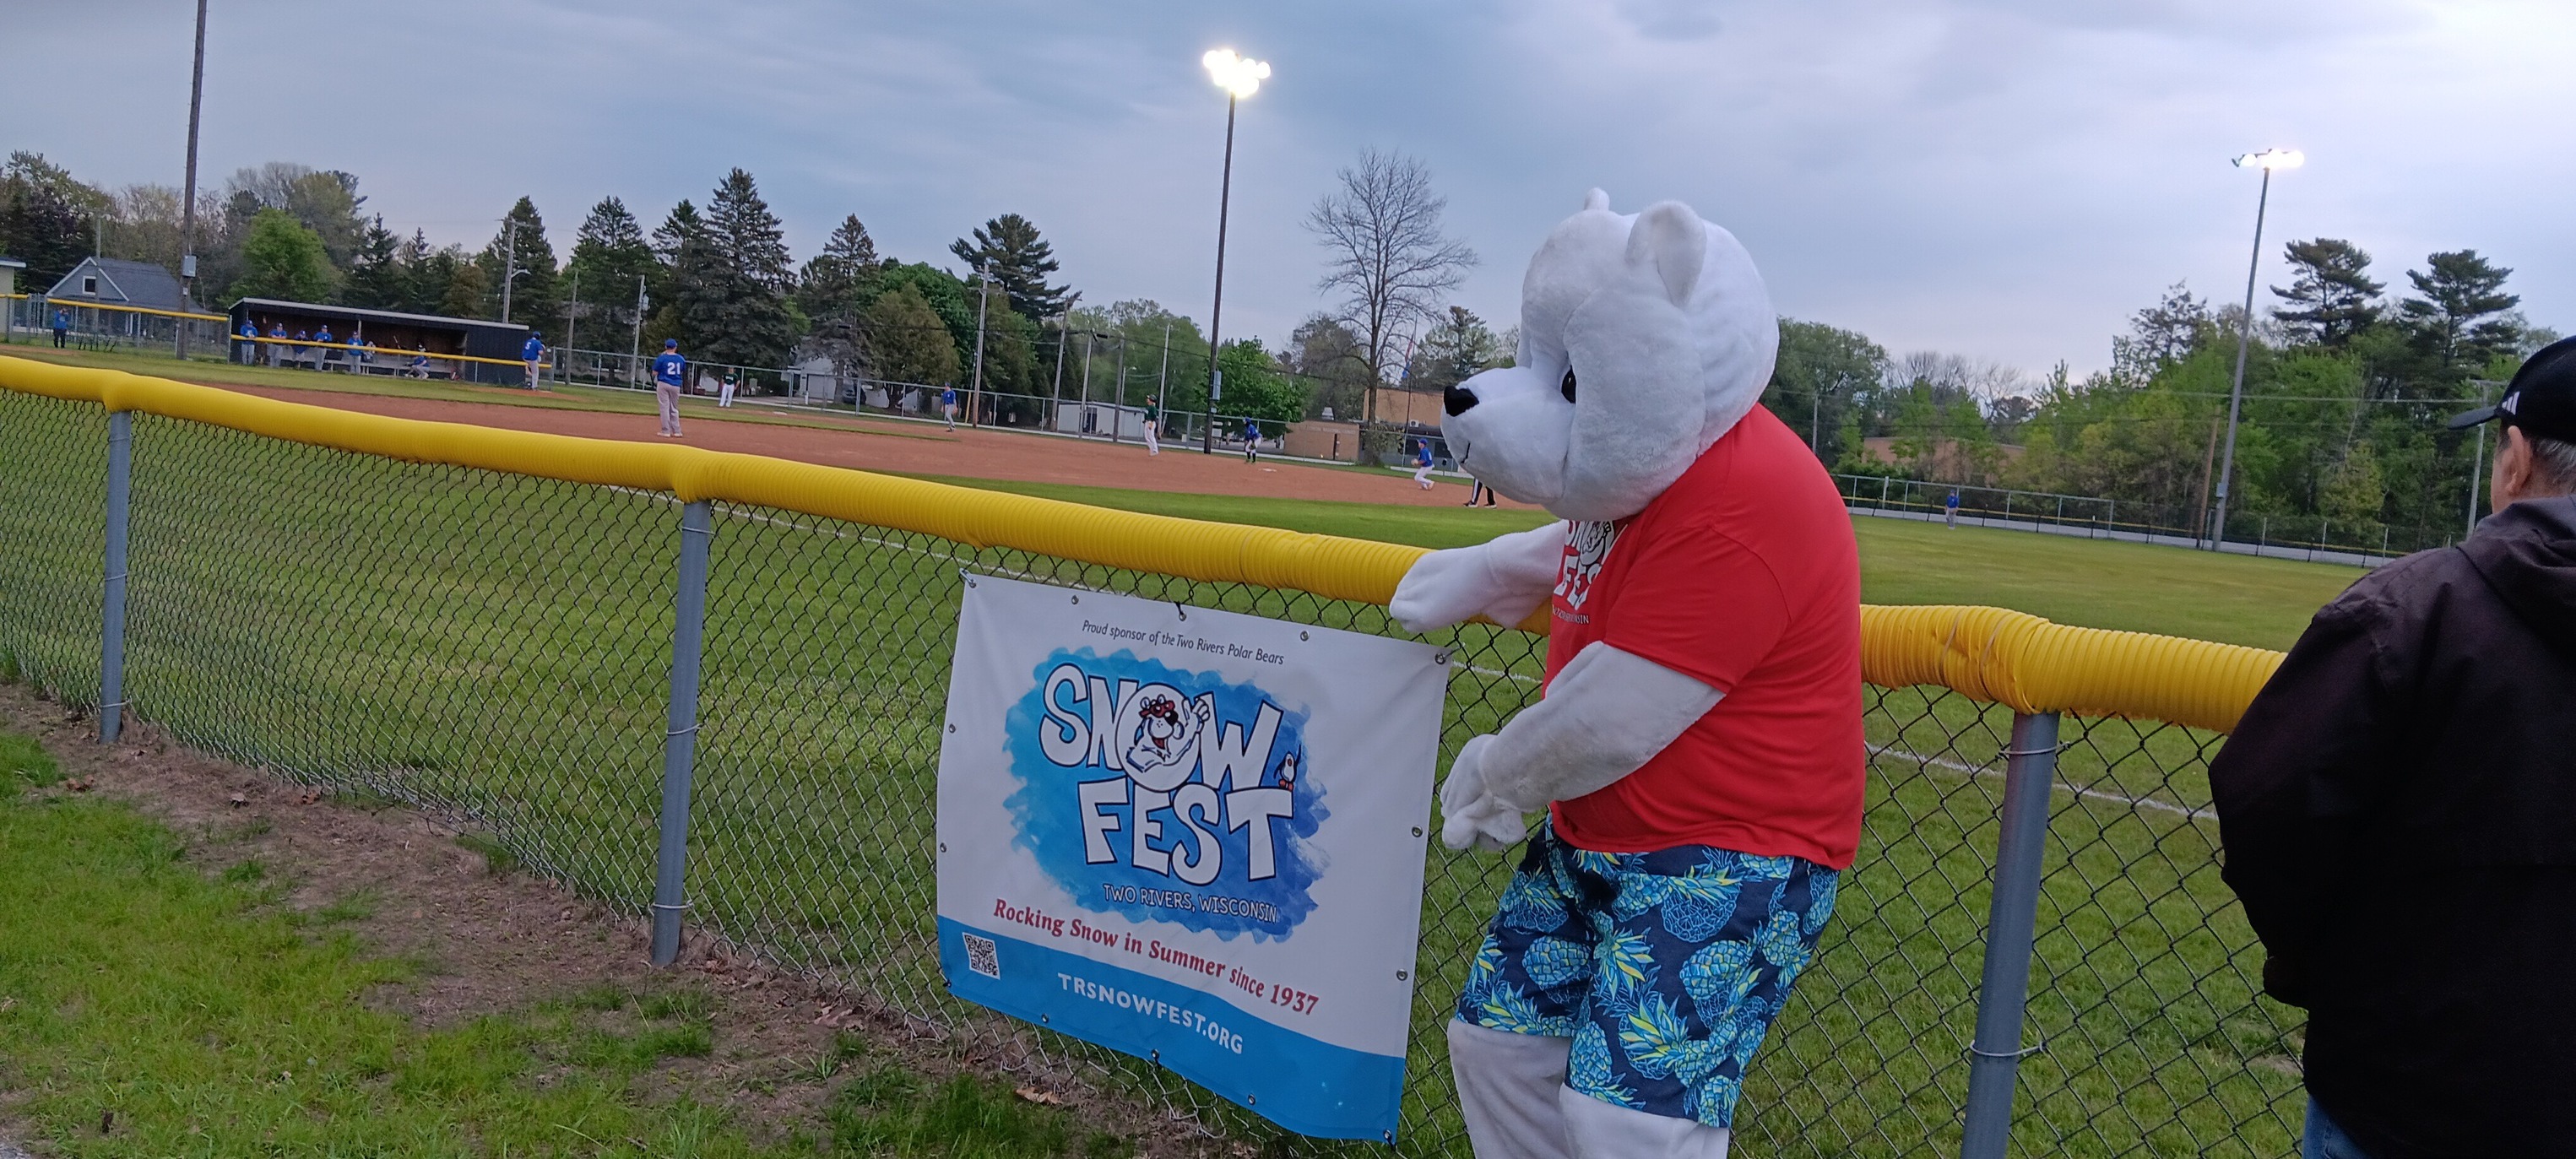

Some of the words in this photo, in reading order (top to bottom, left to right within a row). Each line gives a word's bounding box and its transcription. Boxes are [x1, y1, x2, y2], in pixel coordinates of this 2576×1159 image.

[525, 341, 532, 350] 5
[667, 361, 681, 376] 21
[1082, 619, 1109, 636] Proud
[1109, 626, 1147, 641] sponsor
[1148, 631, 1161, 646] of
[1162, 632, 1175, 646] the
[1176, 633, 1194, 649] Two
[1196, 637, 1225, 655] Rivers
[1227, 643, 1254, 659] Polar
[1255, 648, 1284, 664] Bears
[1039, 663, 1284, 792] SNOW
[1077, 774, 1294, 887] FEST
[1103, 883, 1136, 903] TWO
[1140, 888, 1196, 913] RIVERS,
[1198, 893, 1277, 924] WISCONSIN
[993, 898, 1065, 938] Rocking
[1069, 918, 1119, 947] Snow
[1124, 932, 1142, 955] in
[1148, 940, 1226, 978] Summer
[1228, 966, 1266, 998] since
[1270, 983, 1320, 1015] 1937
[1057, 972, 1244, 1054] TRSNOWFEST.ORG
